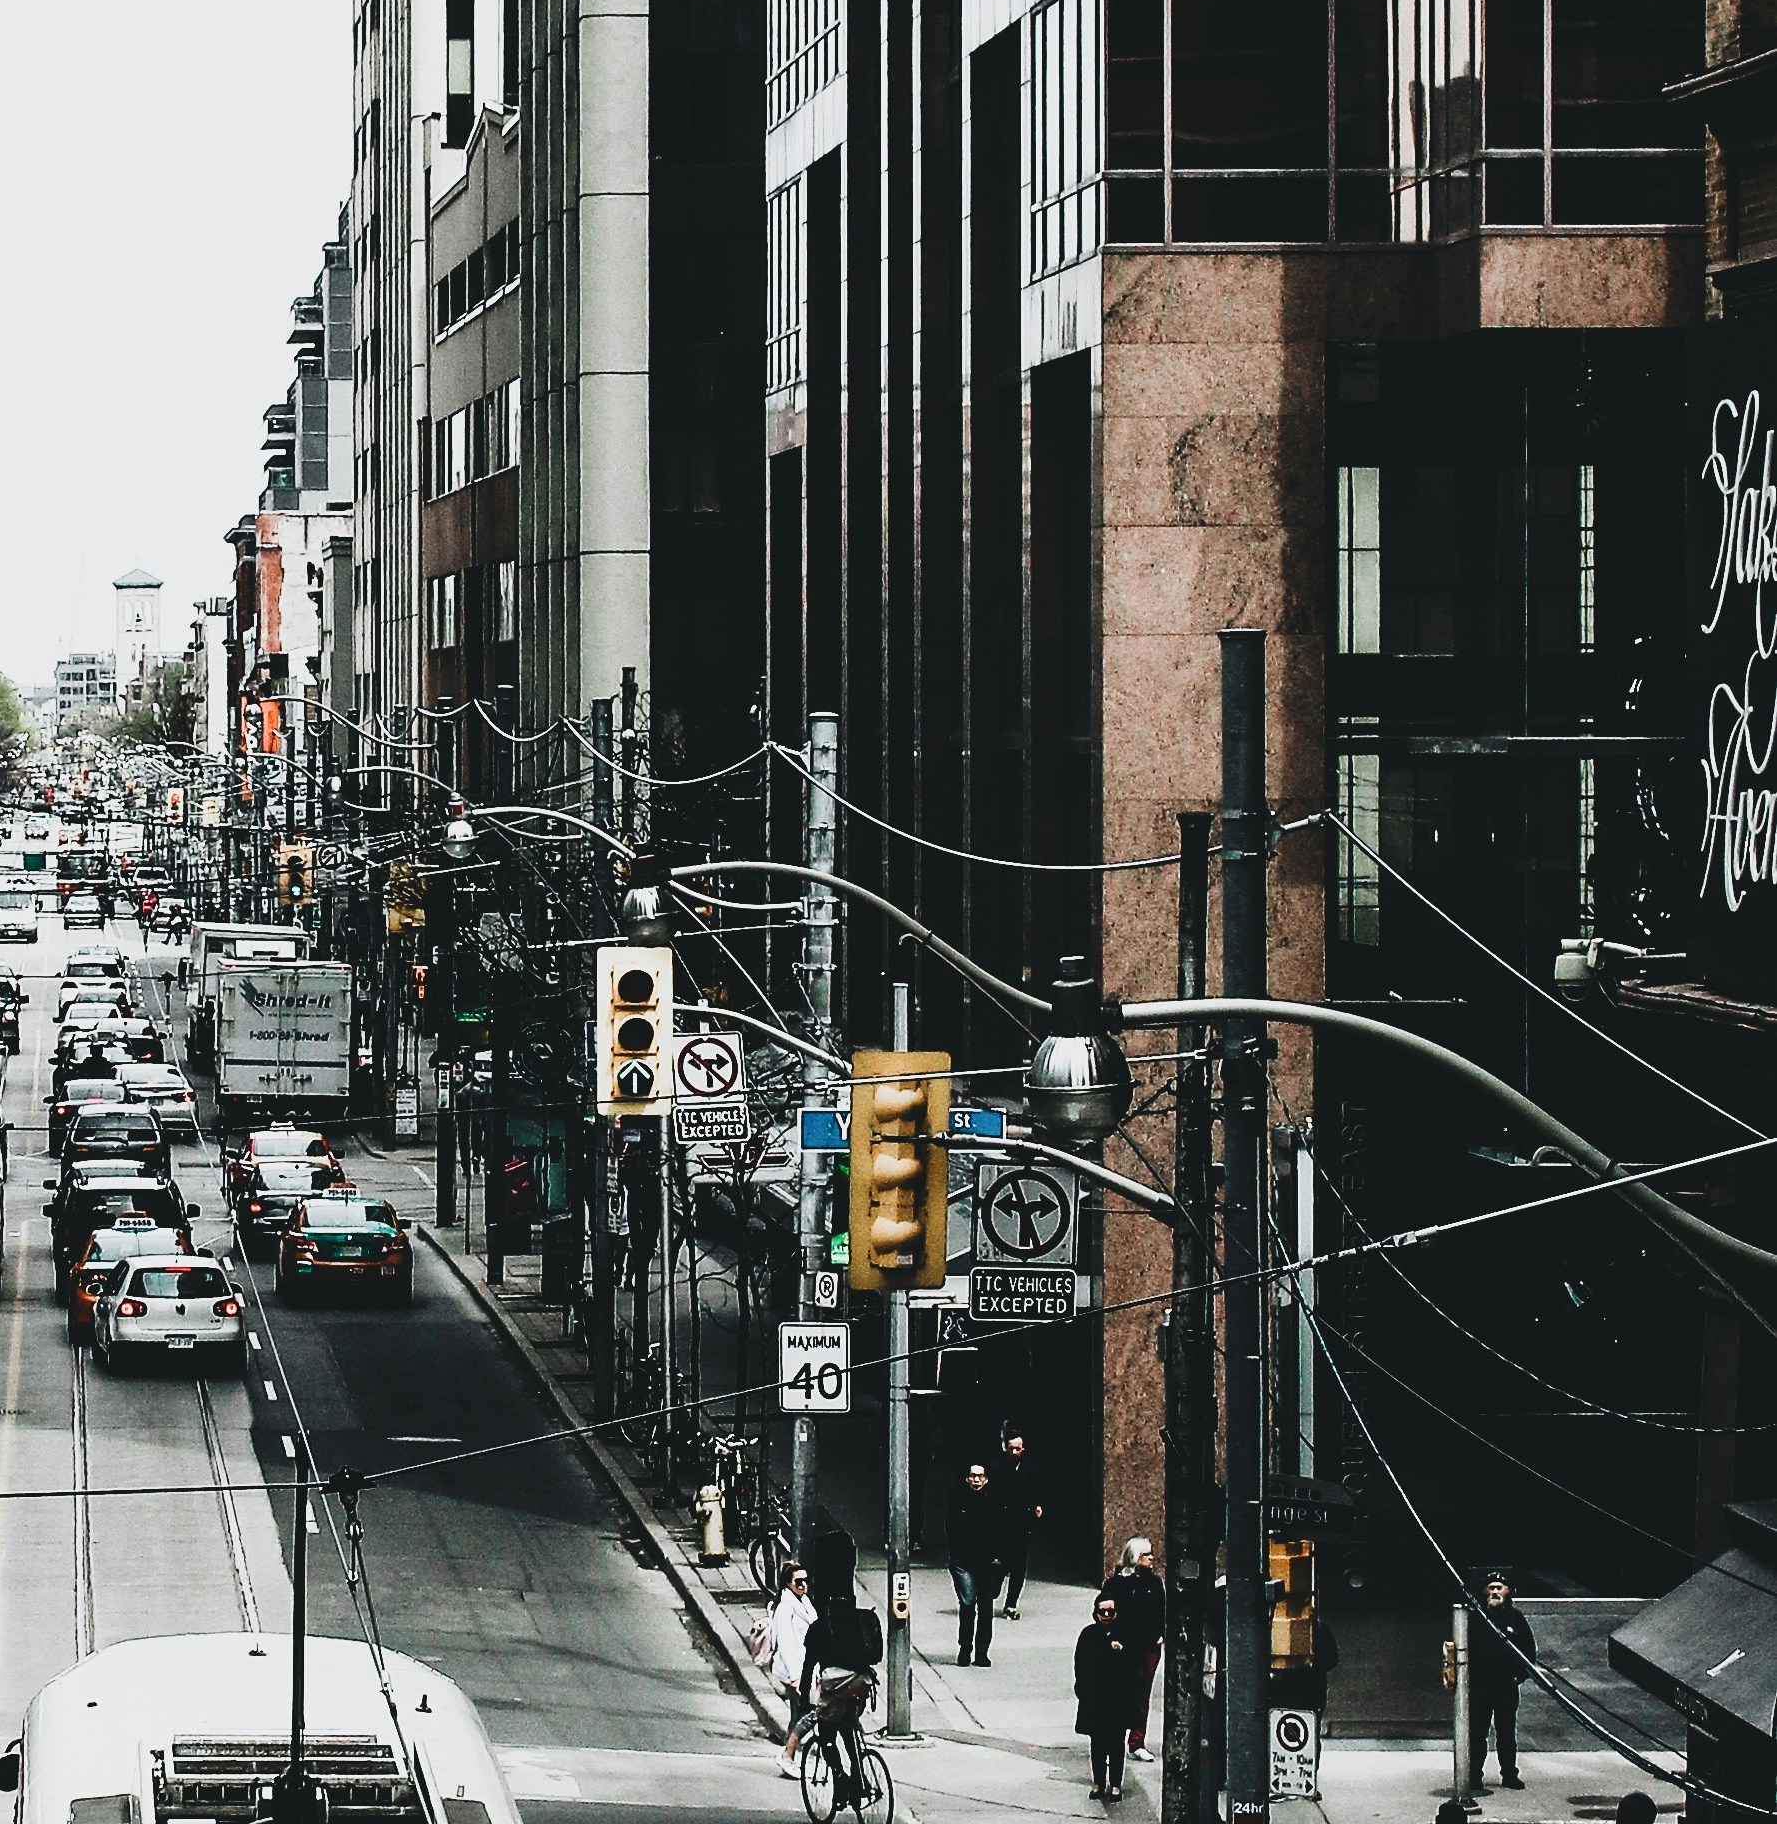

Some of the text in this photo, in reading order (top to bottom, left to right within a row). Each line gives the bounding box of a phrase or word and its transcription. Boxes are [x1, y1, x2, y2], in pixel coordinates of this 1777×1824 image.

[677, 1108, 746, 1124] TTC VEHICLES
[681, 1124, 744, 1138] EXCEPTED
[975, 1276, 1072, 1293] TTC VEHICLES
[979, 1297, 1067, 1313] EXCEPTED
[787, 1335, 841, 1350] MAXIMUM
[788, 1362, 843, 1400] 40
[1234, 1803, 1264, 1814] 24hr
